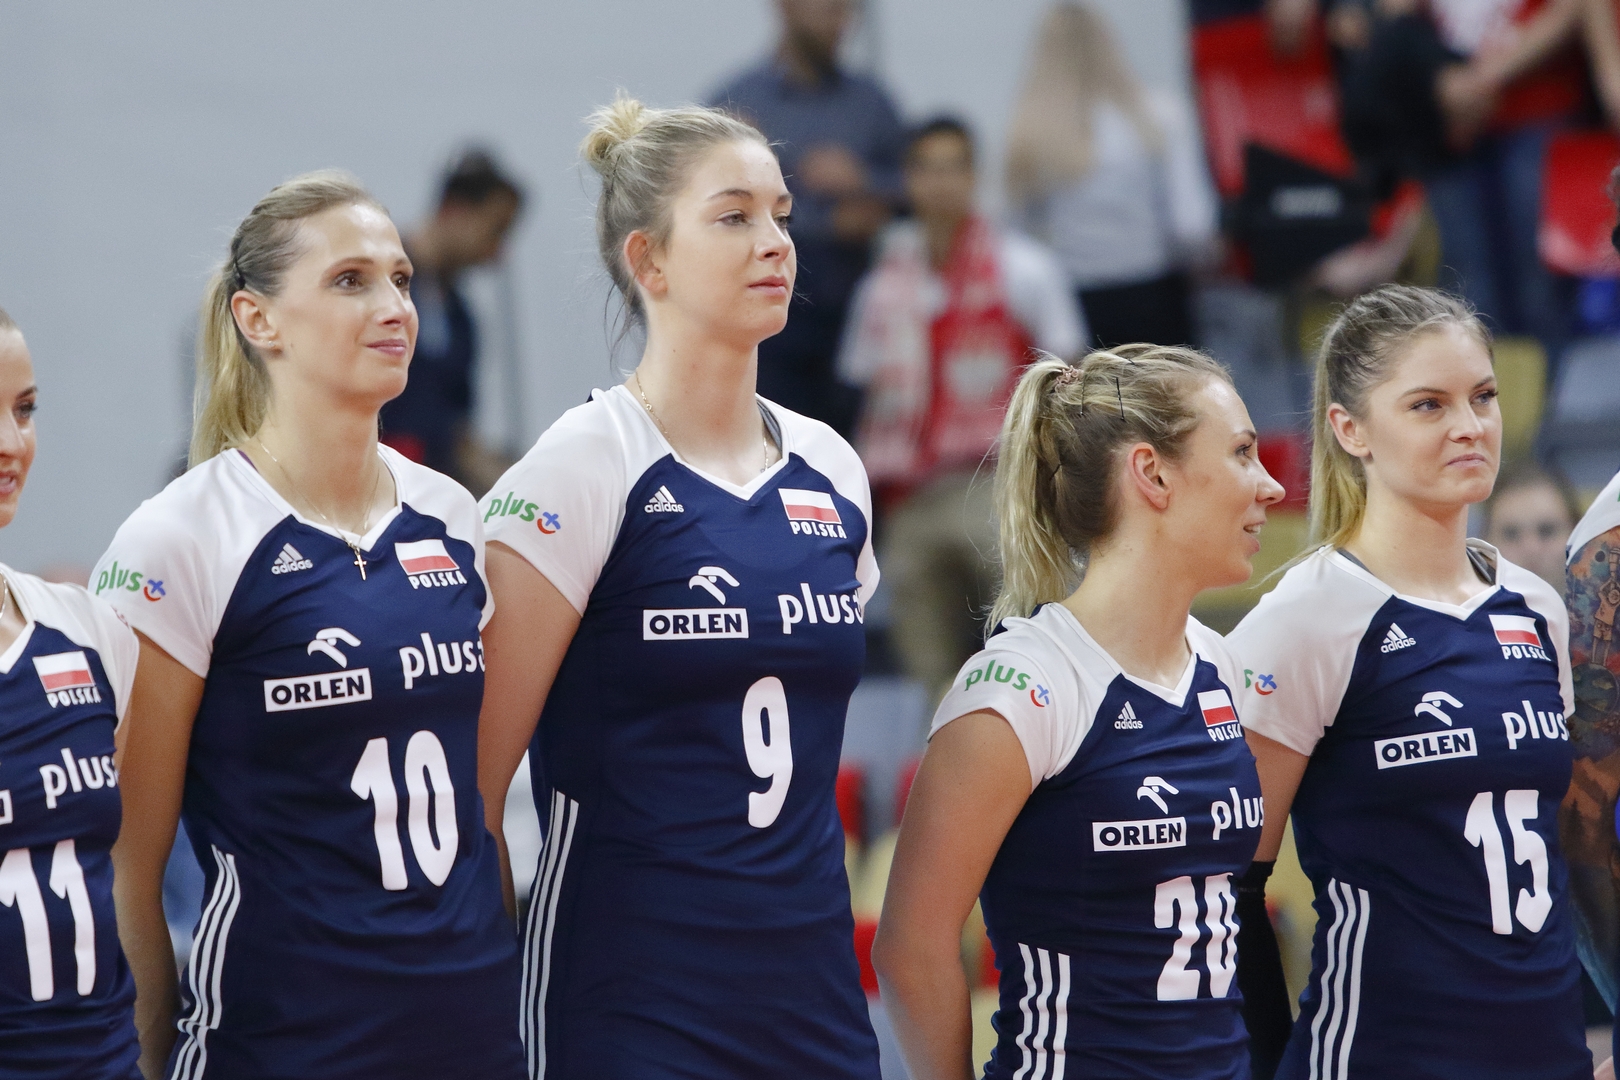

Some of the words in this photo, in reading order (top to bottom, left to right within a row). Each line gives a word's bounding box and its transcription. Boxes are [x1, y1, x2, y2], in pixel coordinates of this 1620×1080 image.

[484, 492, 540, 523] plus
[645, 502, 684, 513] adidas
[790, 521, 847, 538] POLSKA
[96, 561, 143, 595] plus
[271, 559, 313, 575] adidas
[408, 573, 467, 589] POLSKA
[649, 613, 742, 634] ORLEN
[778, 583, 855, 634] plus
[1380, 636, 1416, 653] adidas
[399, 632, 477, 690] plus
[964, 660, 1031, 692] plus
[47, 687, 102, 708] POLSKA
[271, 675, 365, 705] ORLEN
[1114, 719, 1143, 730] adidas
[1502, 700, 1569, 750] plus
[742, 676, 793, 829] 9
[1382, 733, 1472, 762] ORLEN
[39, 747, 116, 810] plus
[350, 730, 459, 890] 10
[1099, 822, 1182, 847] ORLEN
[1464, 789, 1553, 935] 15
[0, 838, 96, 1002] 11
[1154, 873, 1241, 1001] 20
